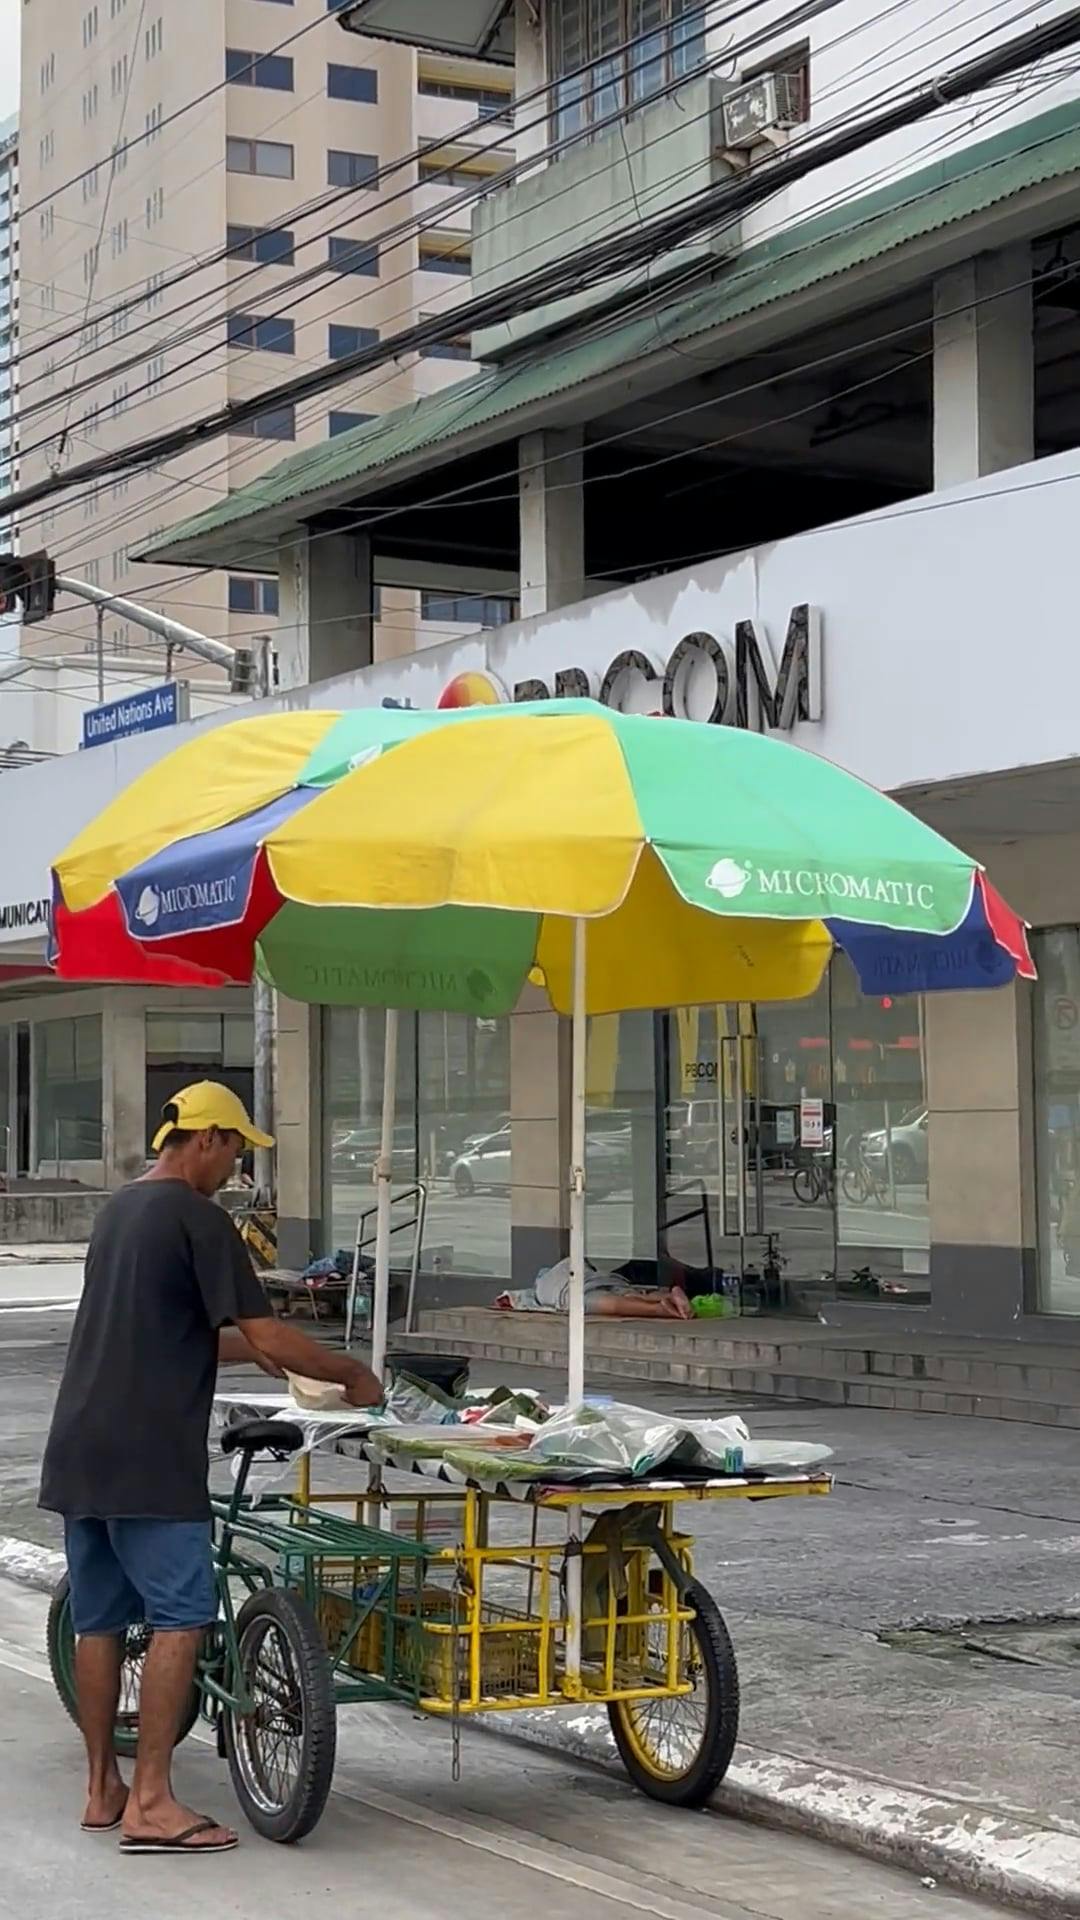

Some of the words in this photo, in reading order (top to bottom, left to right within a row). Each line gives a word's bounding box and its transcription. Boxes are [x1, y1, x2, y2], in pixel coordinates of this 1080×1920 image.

[86, 708, 117, 739] United
[117, 701, 153, 729] Nations
[153, 693, 175, 717] Ave
[160, 875, 236, 914] MICROMATIC
[756, 868, 935, 910] MICROMATIC
[685, 1062, 718, 1078] PBCO
